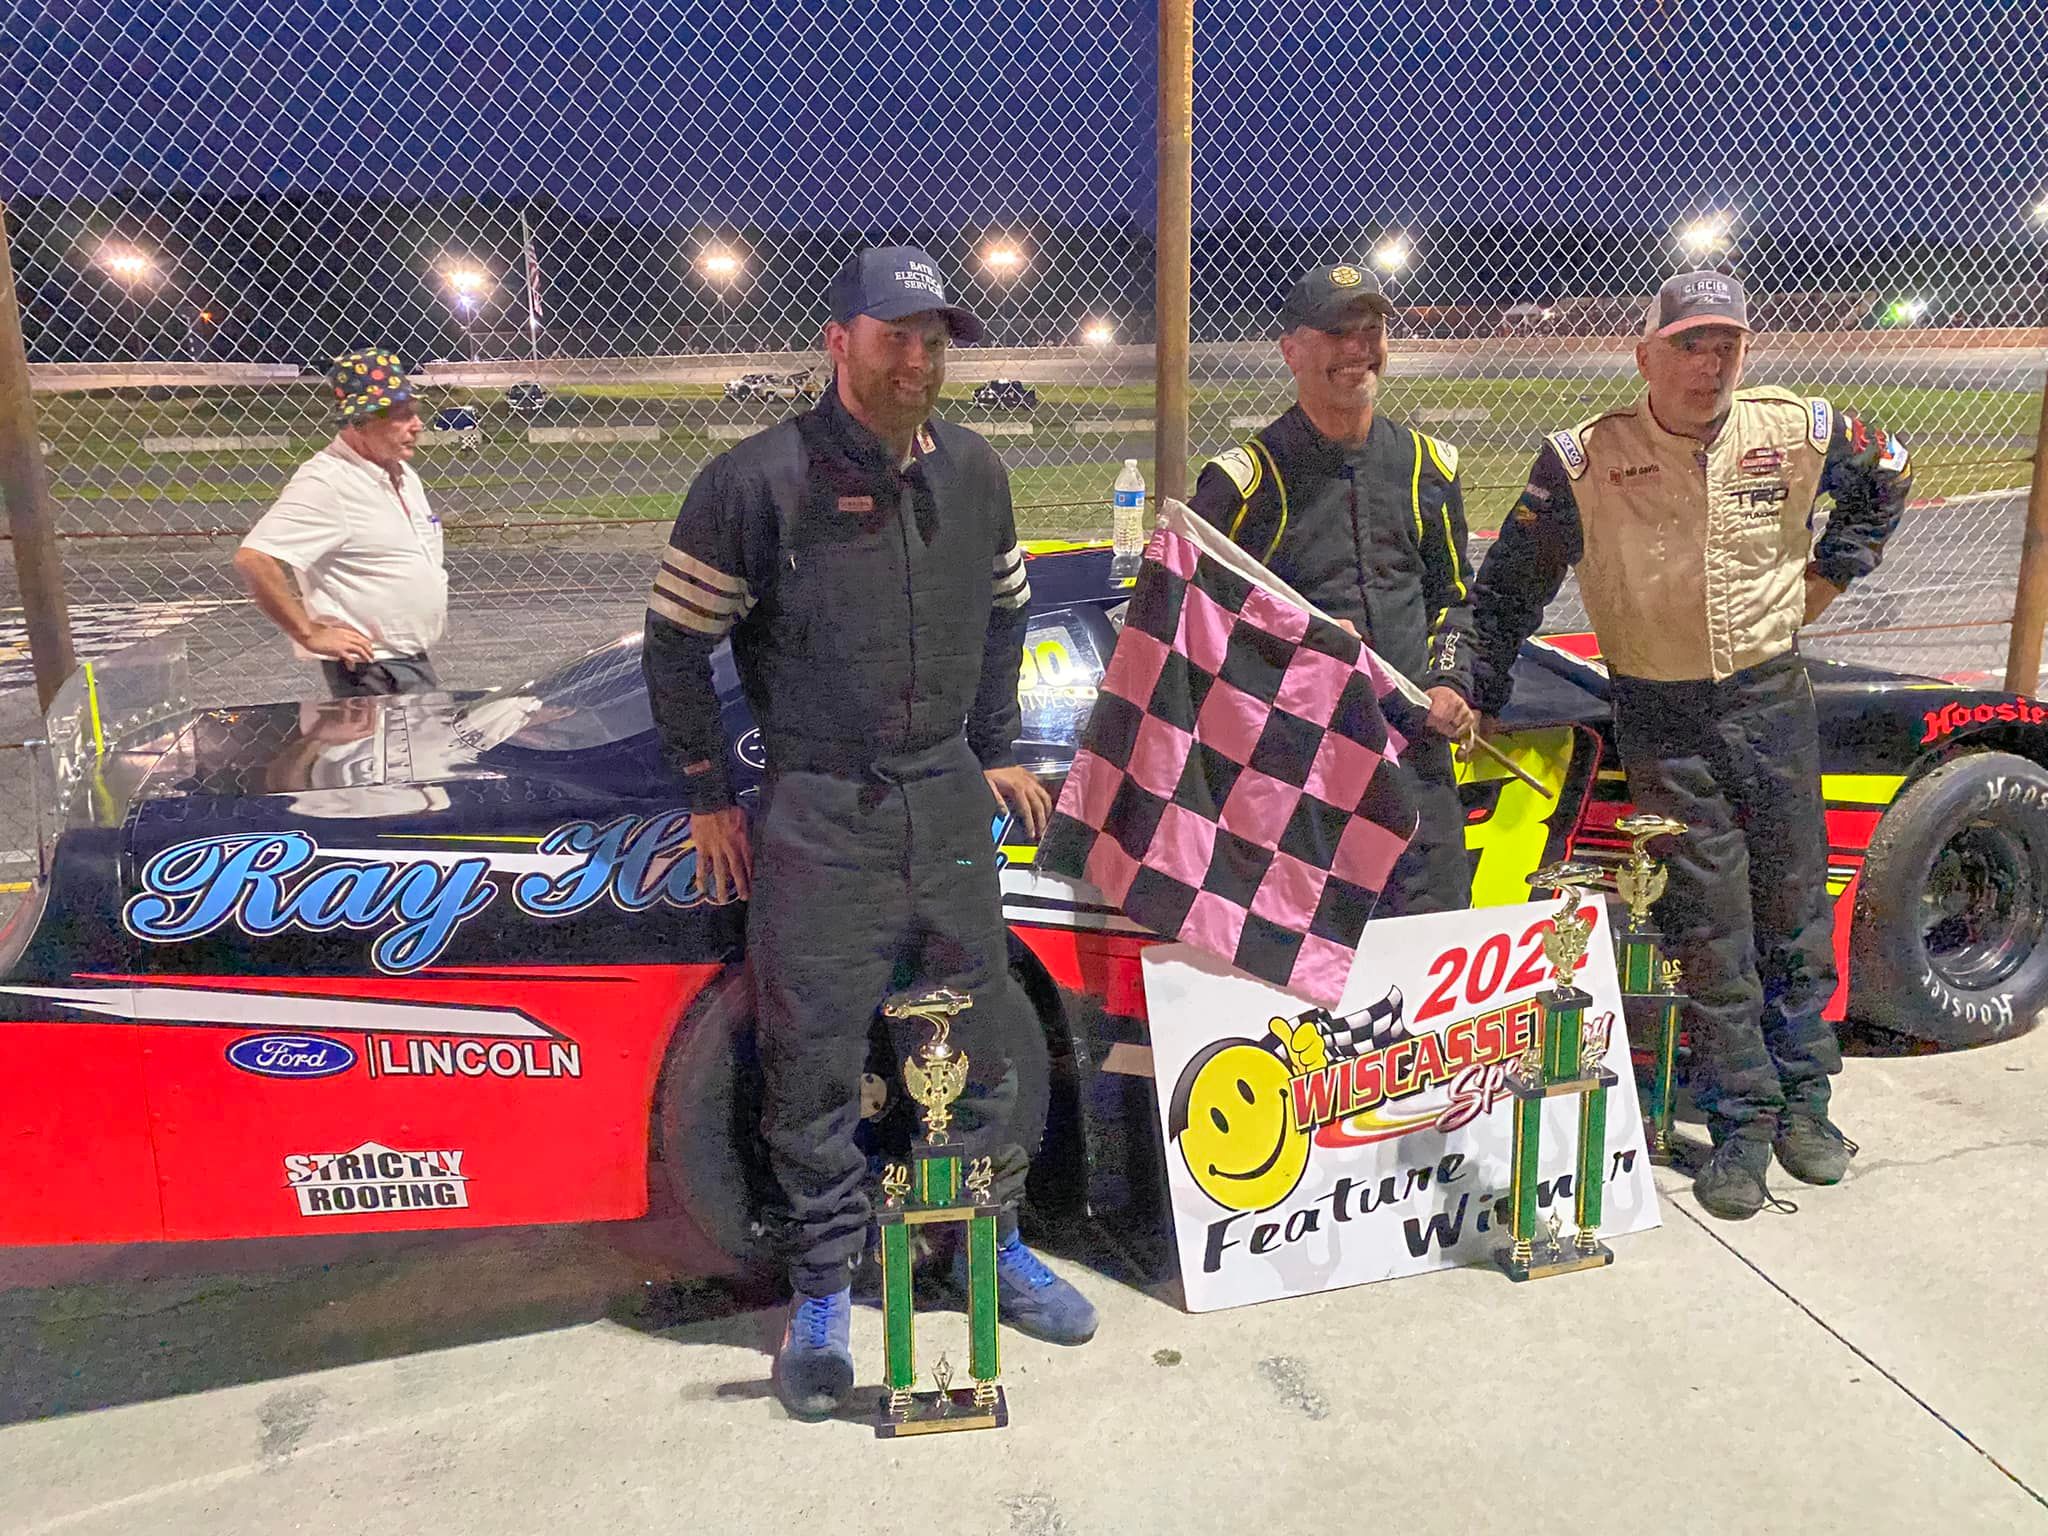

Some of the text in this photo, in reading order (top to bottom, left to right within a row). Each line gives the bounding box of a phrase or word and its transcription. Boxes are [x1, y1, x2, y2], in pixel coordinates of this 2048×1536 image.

[1684, 280, 1728, 293] GLACIER
[1920, 696, 2048, 744] Hoosie
[123, 831, 498, 975] Ray
[1922, 967, 2014, 1031] Hoosier
[256, 1037, 328, 1067] Ford
[380, 1041, 581, 1076] LINCOLN
[285, 1151, 463, 1182] STRICTLY
[881, 1156, 994, 1184] 20 22
[308, 1183, 457, 1211] ROOFING
[1203, 1153, 1466, 1273] Feature
[1403, 1149, 1638, 1259] Winr
